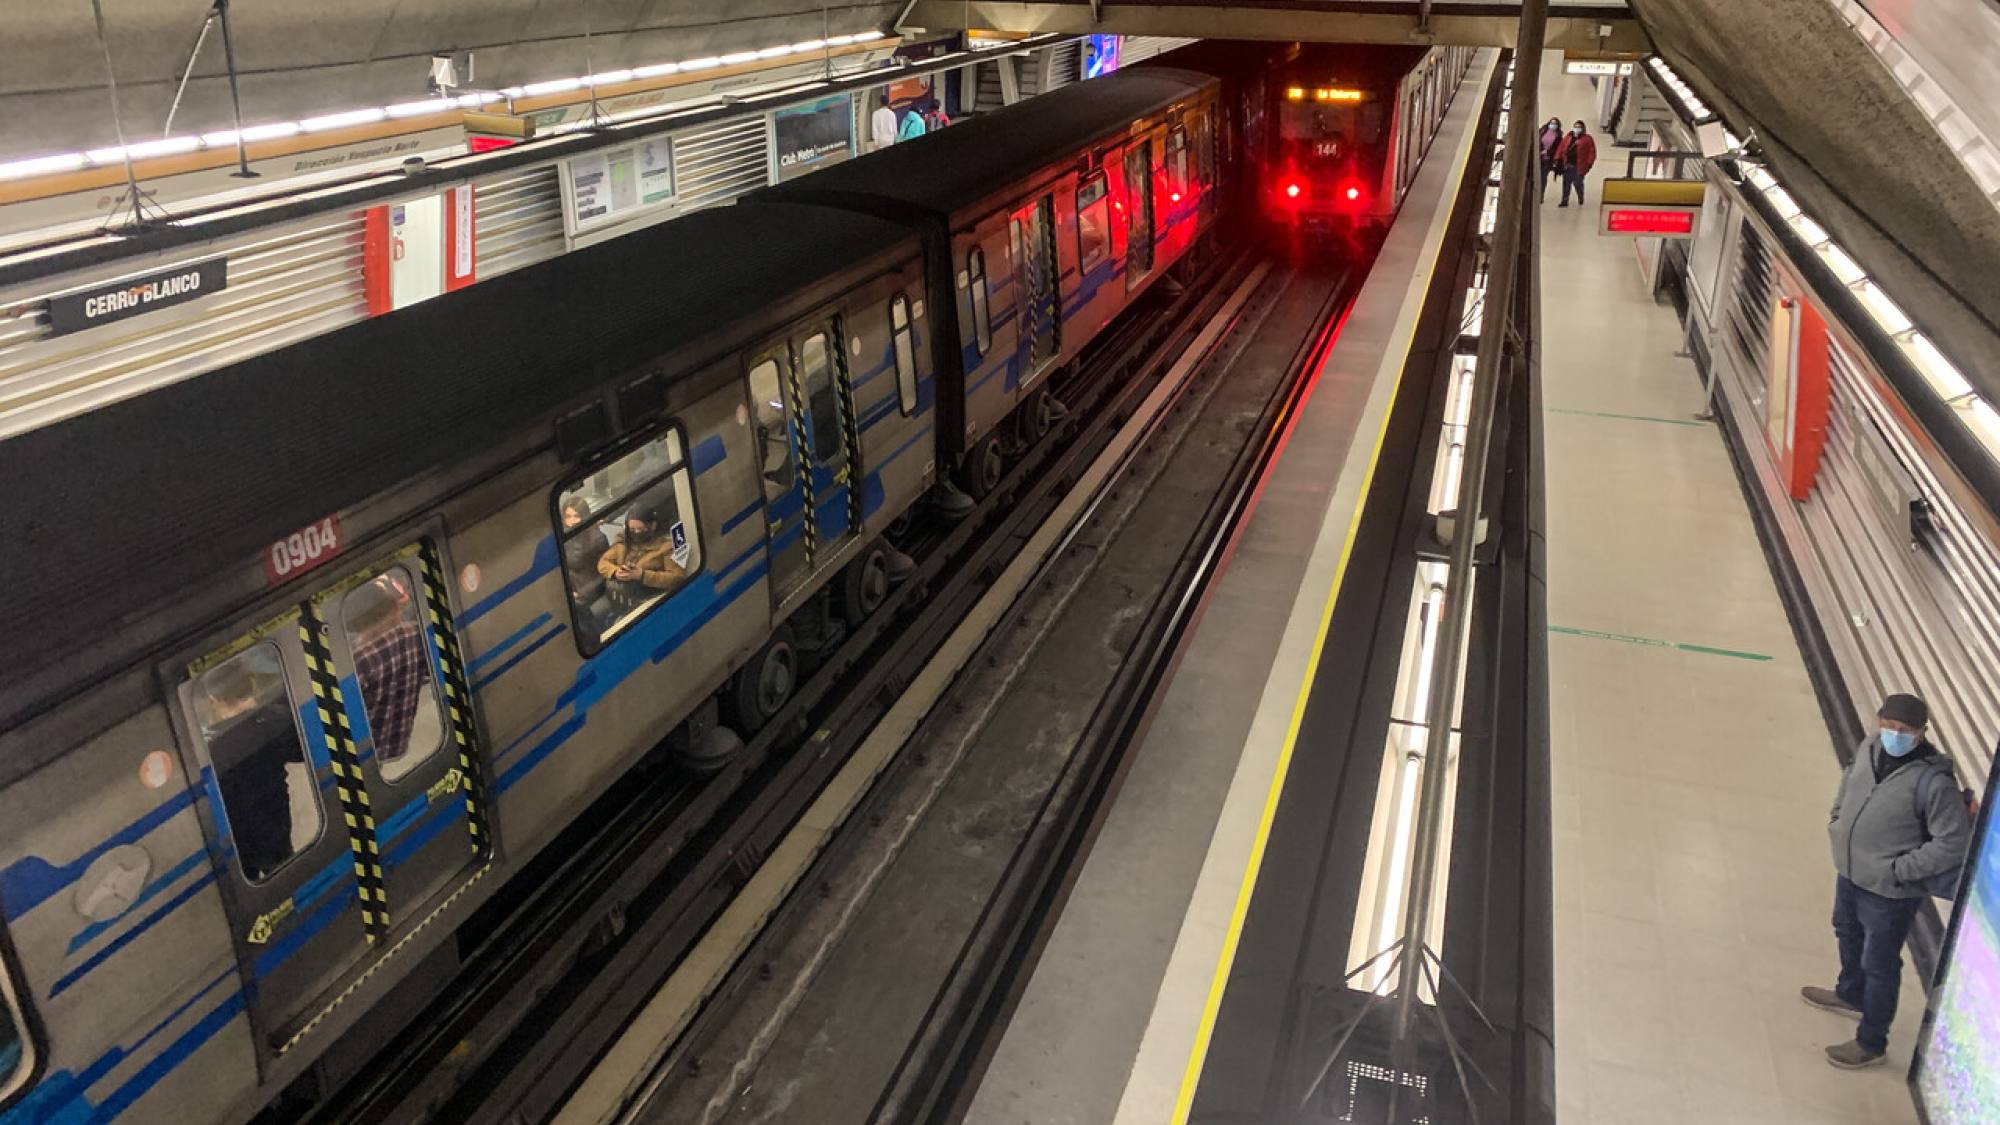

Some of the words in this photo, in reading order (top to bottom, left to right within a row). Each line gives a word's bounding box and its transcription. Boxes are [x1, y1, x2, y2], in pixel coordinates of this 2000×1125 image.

[780, 151, 796, 167] Club
[1316, 143, 1337, 156] 144
[85, 289, 138, 318] CERRO
[143, 272, 200, 303] BLANCO
[272, 518, 337, 576] 0904
